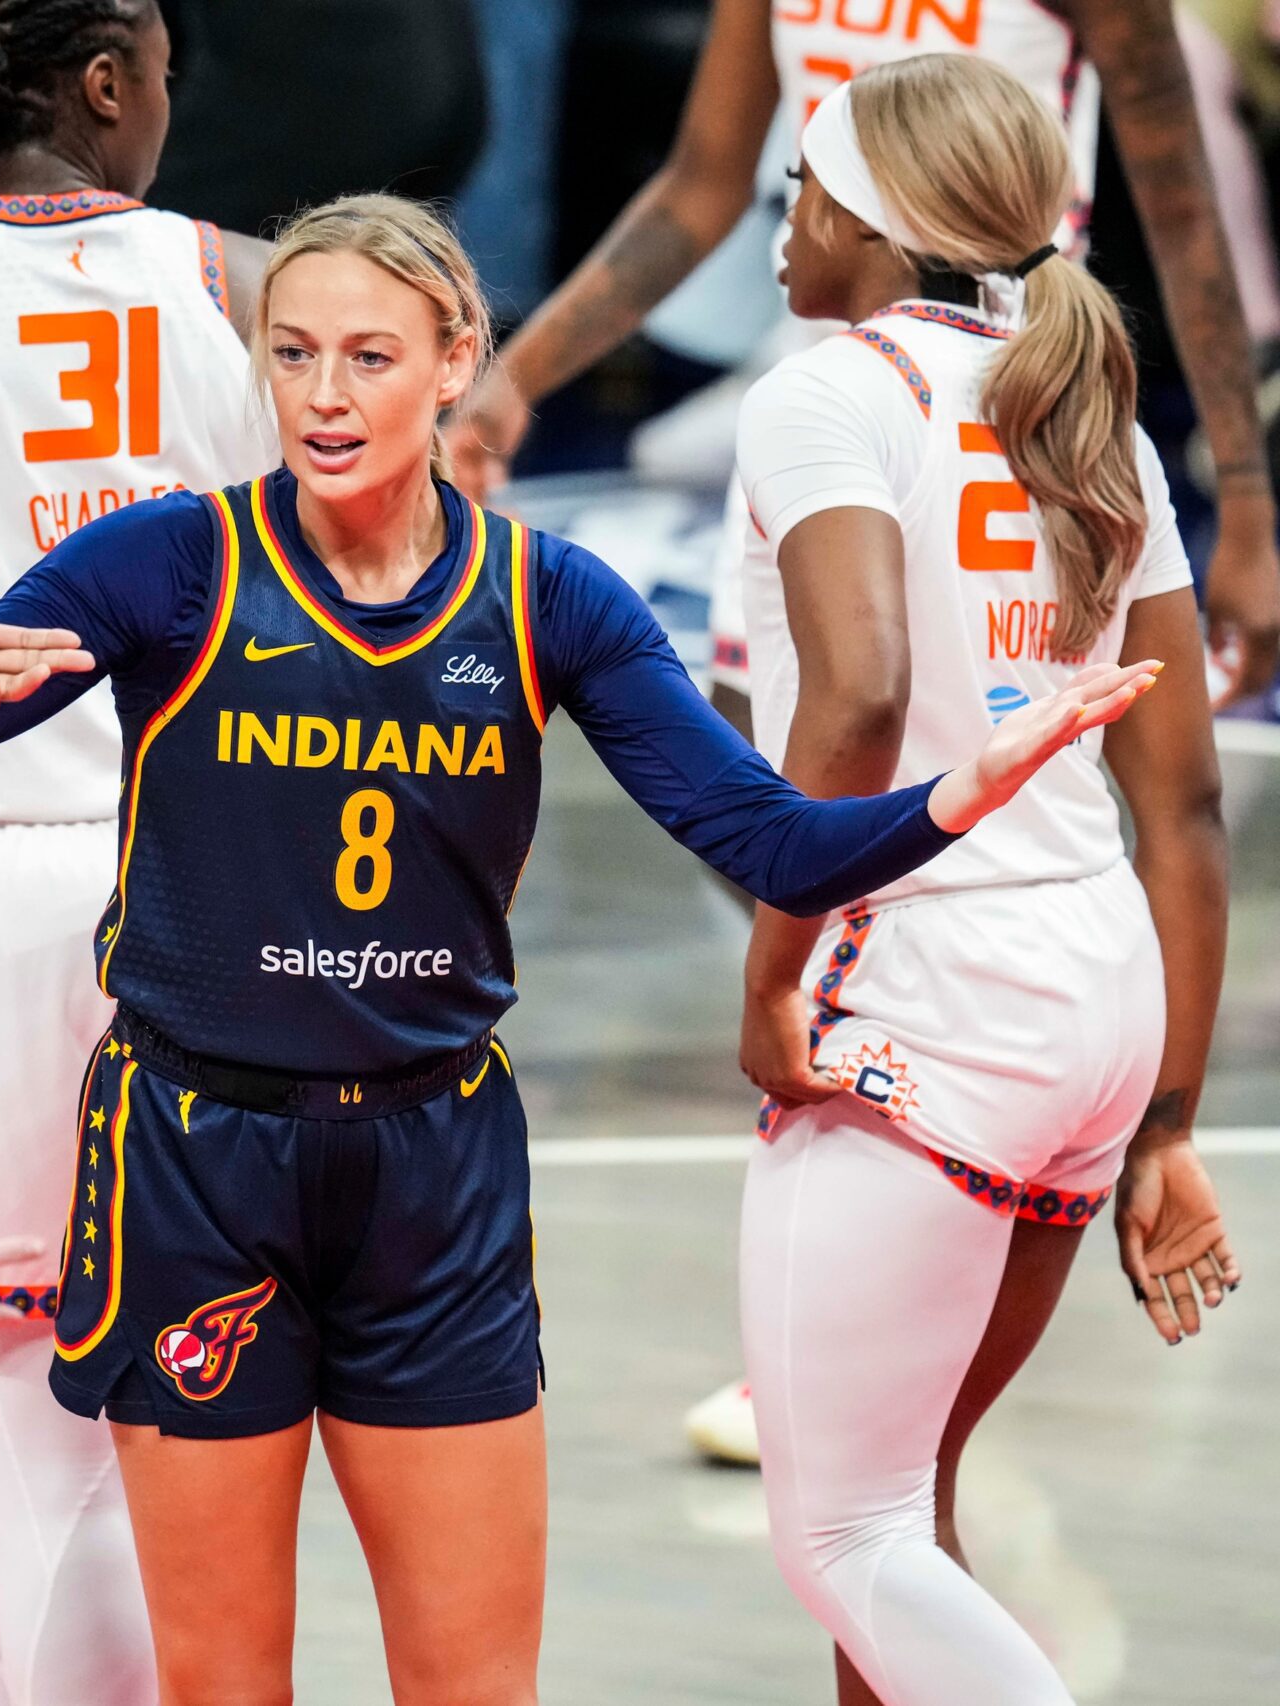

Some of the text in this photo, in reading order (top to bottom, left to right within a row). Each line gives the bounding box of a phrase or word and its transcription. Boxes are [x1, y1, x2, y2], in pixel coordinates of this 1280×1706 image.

[18, 306, 160, 463] 31
[441, 654, 505, 694] Lilly
[217, 710, 506, 776] INDIANA
[334, 788, 395, 911] 8
[259, 939, 453, 990] salesforce
